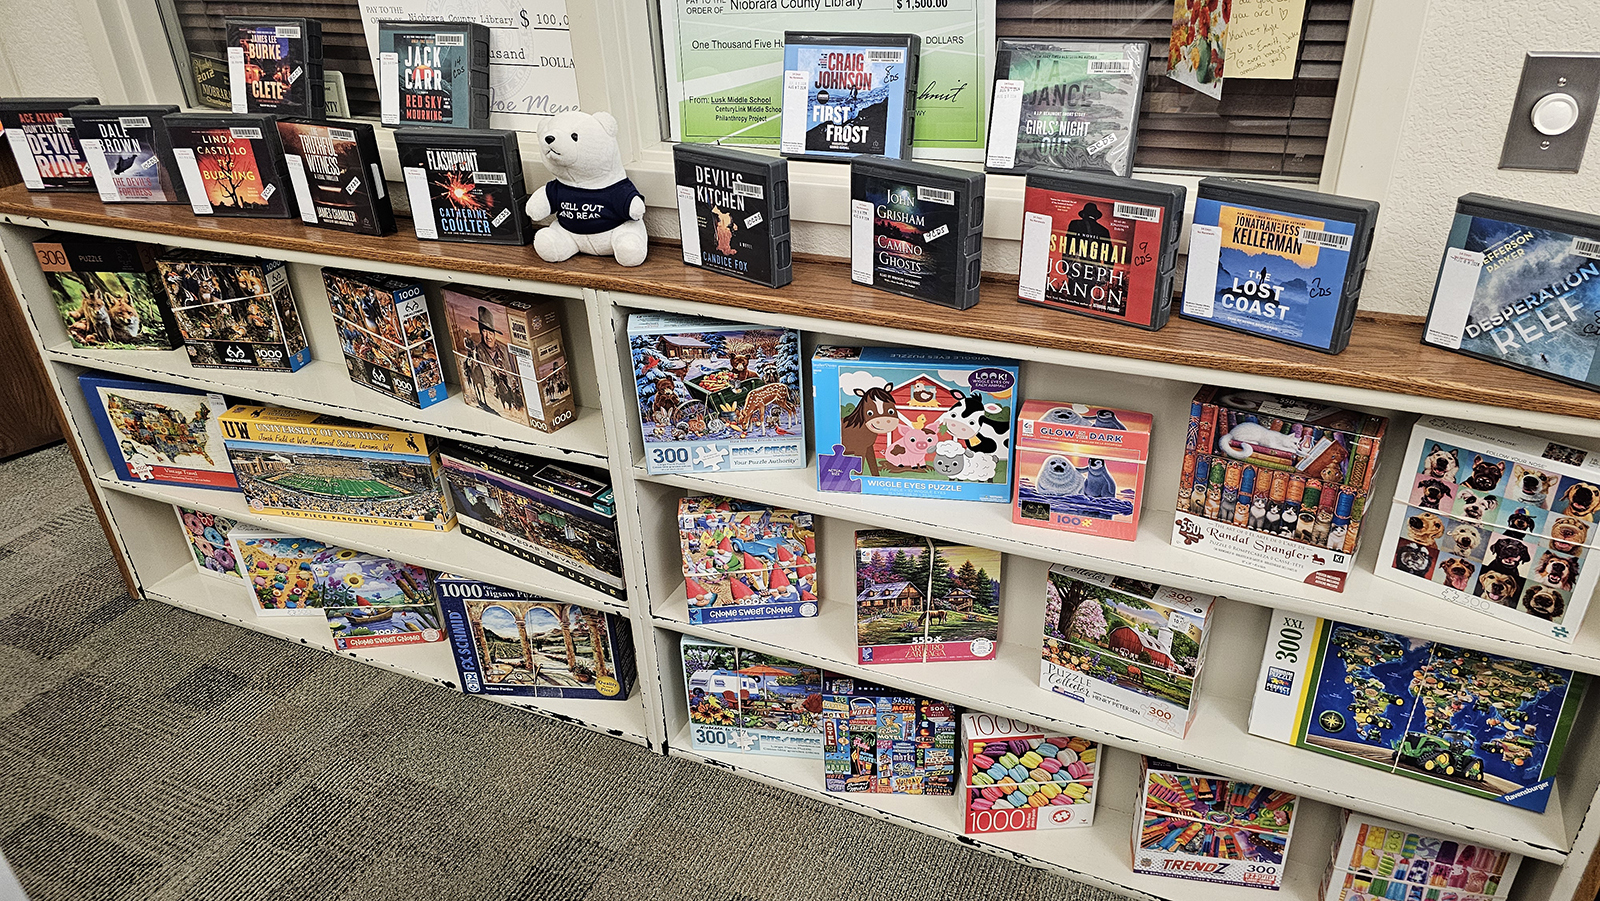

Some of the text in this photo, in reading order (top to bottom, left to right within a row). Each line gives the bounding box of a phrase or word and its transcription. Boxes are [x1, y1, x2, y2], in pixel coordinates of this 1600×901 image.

[731, 0, 863, 11] Niobrara County Library
[408, 13, 444, 22] Niobrara
[480, 15, 514, 26] Library
[251, 34, 278, 44] JAMES LEE
[692, 40, 709, 49] One
[712, 39, 752, 49] Thousand
[755, 39, 772, 48] Five
[925, 35, 964, 44] DOLLARS
[249, 43, 281, 60] BURKE
[404, 46, 441, 68] JACK
[828, 52, 864, 71] CRAIG
[197, 69, 215, 83] 2012
[404, 68, 442, 91] CARR
[815, 71, 872, 91] JOHNSON
[883, 73, 899, 83] CDS
[252, 80, 284, 99] CLETE
[1028, 84, 1093, 107] JANCE
[406, 94, 442, 109] RED SKY
[689, 95, 772, 104] From: Lusk Middle School
[406, 109, 443, 121] MOURNING
[715, 106, 746, 114] CenturyLink
[812, 105, 851, 123] FIRST
[19, 113, 34, 124] ACE
[715, 115, 767, 123] Philanthropy Project
[22, 124, 41, 133] DON'T
[41, 124, 55, 133] LET
[98, 123, 130, 138] DALE
[826, 124, 870, 144] FROST
[1059, 121, 1090, 137] NIGHT
[26, 133, 79, 155] DEVIL
[99, 138, 141, 153] BROWN
[201, 135, 235, 144] LINDA
[299, 134, 338, 157] TRUTHFUL
[1041, 136, 1071, 156] OUT
[196, 146, 247, 156] CASTILLO
[34, 155, 83, 178] RIDE
[305, 153, 341, 176] WITNESS
[426, 150, 479, 172] FLASHPOINT
[113, 177, 152, 187] THE DEVIL'S
[203, 170, 256, 181] BURNING
[119, 187, 153, 197] FORTRESS
[697, 185, 745, 212] KITCHEN
[887, 189, 915, 207] JOHN
[316, 207, 358, 223] JAMES CHANDLER
[439, 207, 488, 219] CATHERINE
[582, 203, 604, 212] OUT
[576, 212, 601, 220] READ
[877, 205, 925, 227] GRISHAM
[441, 218, 491, 233] COULTER
[1235, 215, 1301, 237] JONATHAN JESS
[877, 235, 923, 256] CAMINO
[1232, 226, 1303, 255] KELLERMAN
[1481, 230, 1534, 266] EFFERSON
[1050, 234, 1127, 264] SHANGHAI
[38, 250, 66, 265] 300
[78, 254, 103, 263] PUZZLE
[703, 251, 748, 272] CANDICE FOX
[879, 250, 921, 272] GHOSTS
[1134, 254, 1152, 266] CDS
[1485, 248, 1526, 274] PARKER
[1046, 258, 1124, 286] JOSEPH
[1248, 269, 1272, 281] THE
[398, 287, 420, 300] 1000
[1046, 276, 1123, 305] KANON
[1232, 277, 1285, 302] LOST
[1309, 287, 1332, 298] CDS
[1221, 293, 1290, 320] COAST
[1465, 262, 1600, 339] DESPERATION
[1489, 290, 1584, 355] REEF
[256, 349, 282, 358] 1000
[975, 372, 1008, 381] LOOK!
[529, 418, 548, 432] 1000
[552, 410, 572, 426] 1000
[222, 420, 250, 440] UW
[255, 423, 390, 441] UNIVERSITY OF WYOMING
[1040, 427, 1075, 438] GLOW
[1089, 432, 1123, 443] DARK
[653, 447, 688, 464] 300
[867, 480, 962, 492] WIGGLE EYES PUZZLE
[332, 515, 378, 525] PANORAMIC
[383, 520, 414, 528] PUZZLE
[1057, 515, 1081, 526] 100
[1180, 520, 1200, 534] 550
[490, 528, 503, 538] LAS
[546, 551, 584, 570] NEVADA
[1206, 526, 1250, 546] Randal
[1253, 539, 1309, 561] Spangler
[466, 528, 617, 595] PANORAMIC PUZZLE
[440, 583, 483, 598] 1000
[484, 590, 515, 599] Jigsaw
[1170, 591, 1193, 603] 300
[1463, 594, 1491, 611] 300
[1283, 617, 1305, 630] XXL
[449, 610, 471, 655] SCHMID
[1275, 628, 1303, 664] 300
[1048, 663, 1092, 687] PUZZLE
[1269, 671, 1294, 682] PUZZLE
[1266, 682, 1291, 693] PERFECT
[851, 708, 874, 716] MOTEL
[1149, 707, 1172, 720] 300
[696, 729, 726, 745] 300
[1504, 780, 1550, 802] Ravensburger
[970, 810, 1026, 832] 1000
[1163, 858, 1231, 875] TRENDZ
[1246, 864, 1276, 875] 300
